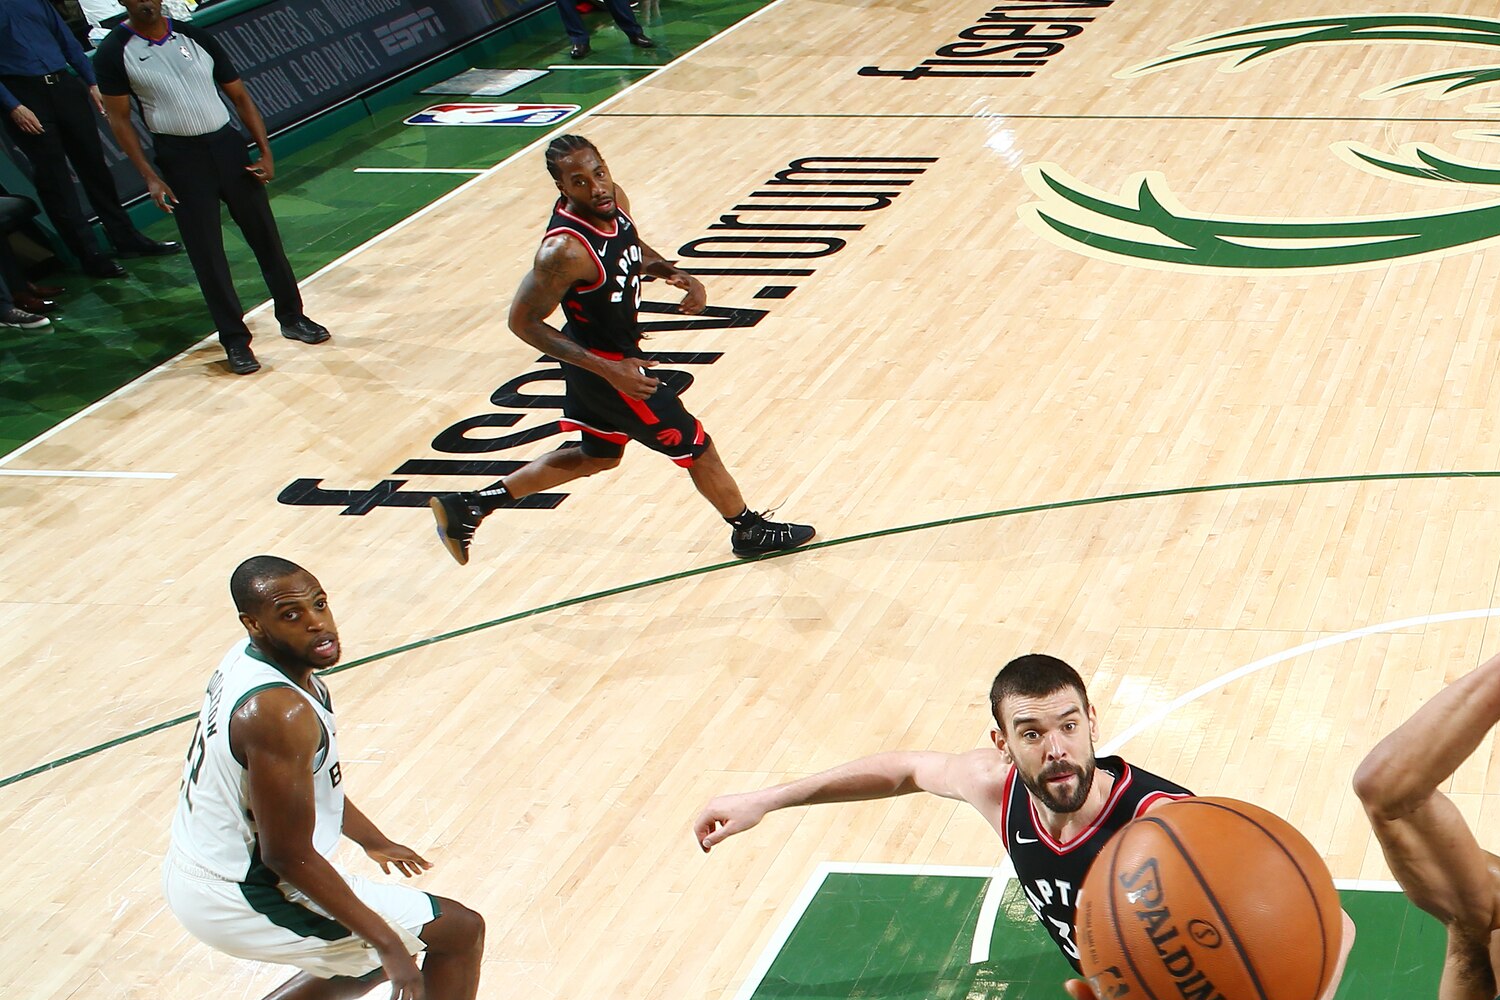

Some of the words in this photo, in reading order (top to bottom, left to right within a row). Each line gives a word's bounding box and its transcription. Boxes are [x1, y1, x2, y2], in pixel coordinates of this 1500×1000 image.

[213, 30, 257, 73] AIL
[234, 6, 316, 63] BLAZERS
[373, 6, 446, 57] ESPN
[611, 244, 643, 303] RAPTO
[1046, 914, 1082, 960] 3
